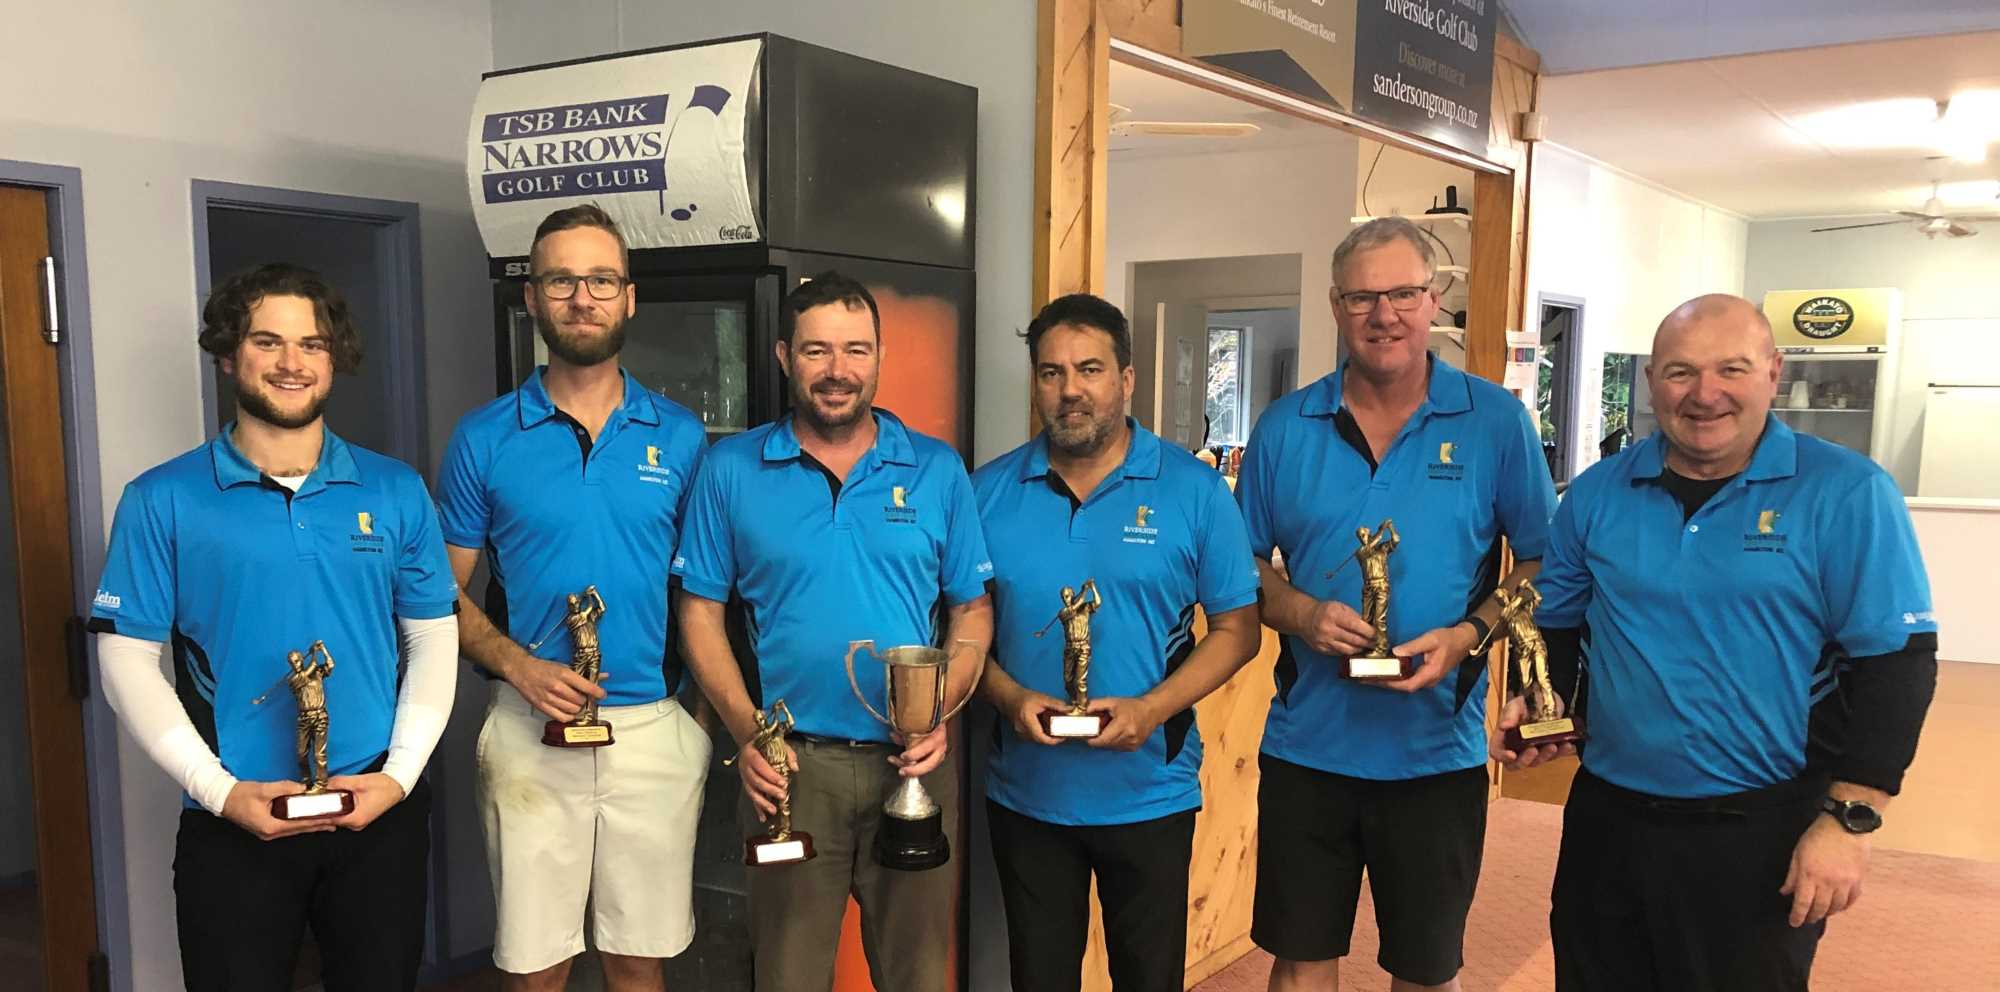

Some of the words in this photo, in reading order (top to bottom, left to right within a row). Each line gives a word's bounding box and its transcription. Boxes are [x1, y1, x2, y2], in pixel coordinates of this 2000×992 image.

[1436, 8, 1459, 40] Golf
[1458, 20, 1479, 52] Club
[498, 111, 555, 136] TSB
[562, 102, 649, 129] BANK
[1373, 71, 1479, 129] sandersongroup.co.nz
[482, 130, 663, 173] NARROWS
[496, 174, 566, 197] GOLF
[576, 167, 650, 190] CLUB
[1804, 298, 1845, 314] WAIKATO
